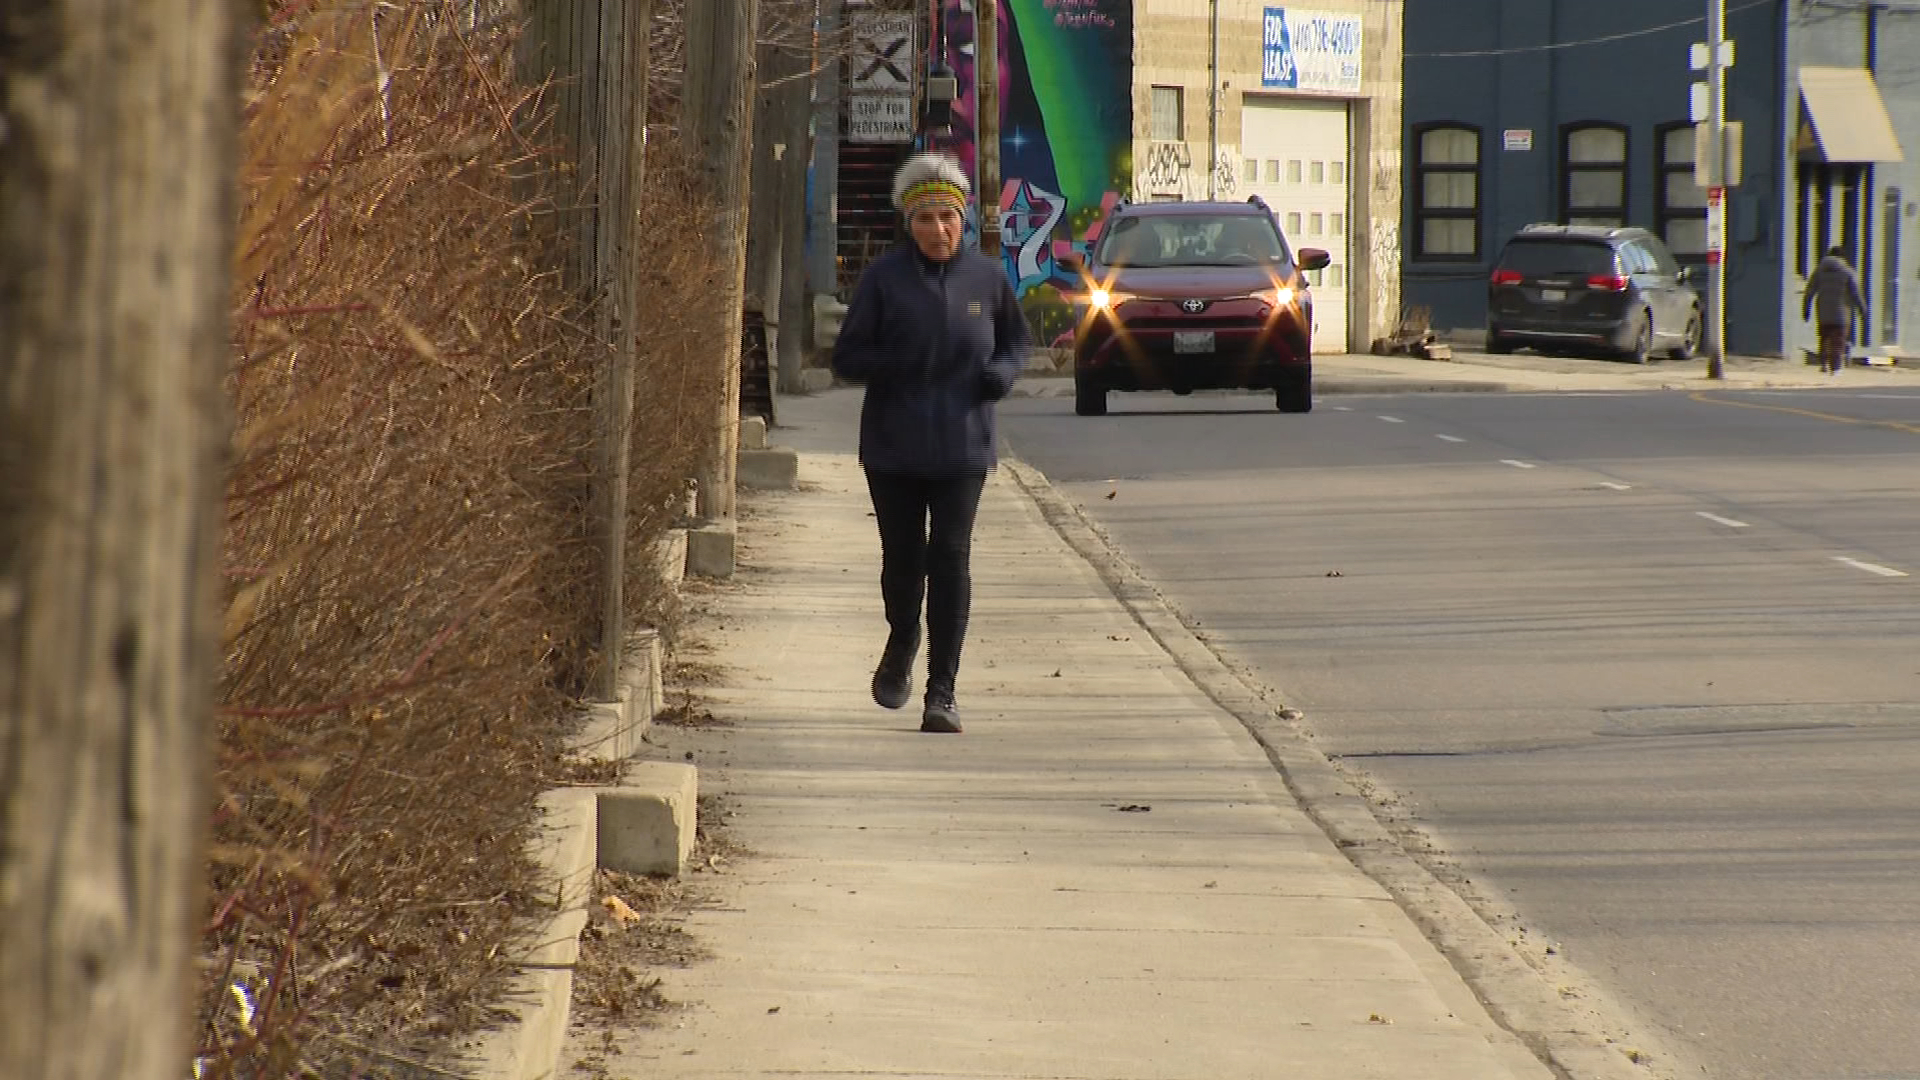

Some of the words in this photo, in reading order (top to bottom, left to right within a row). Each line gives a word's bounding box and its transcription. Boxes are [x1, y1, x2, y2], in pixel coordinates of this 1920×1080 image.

[1265, 15, 1282, 46] FOR
[1264, 49, 1293, 81] LEASE
[858, 102, 882, 115] STOP
[886, 102, 905, 115] FOR
